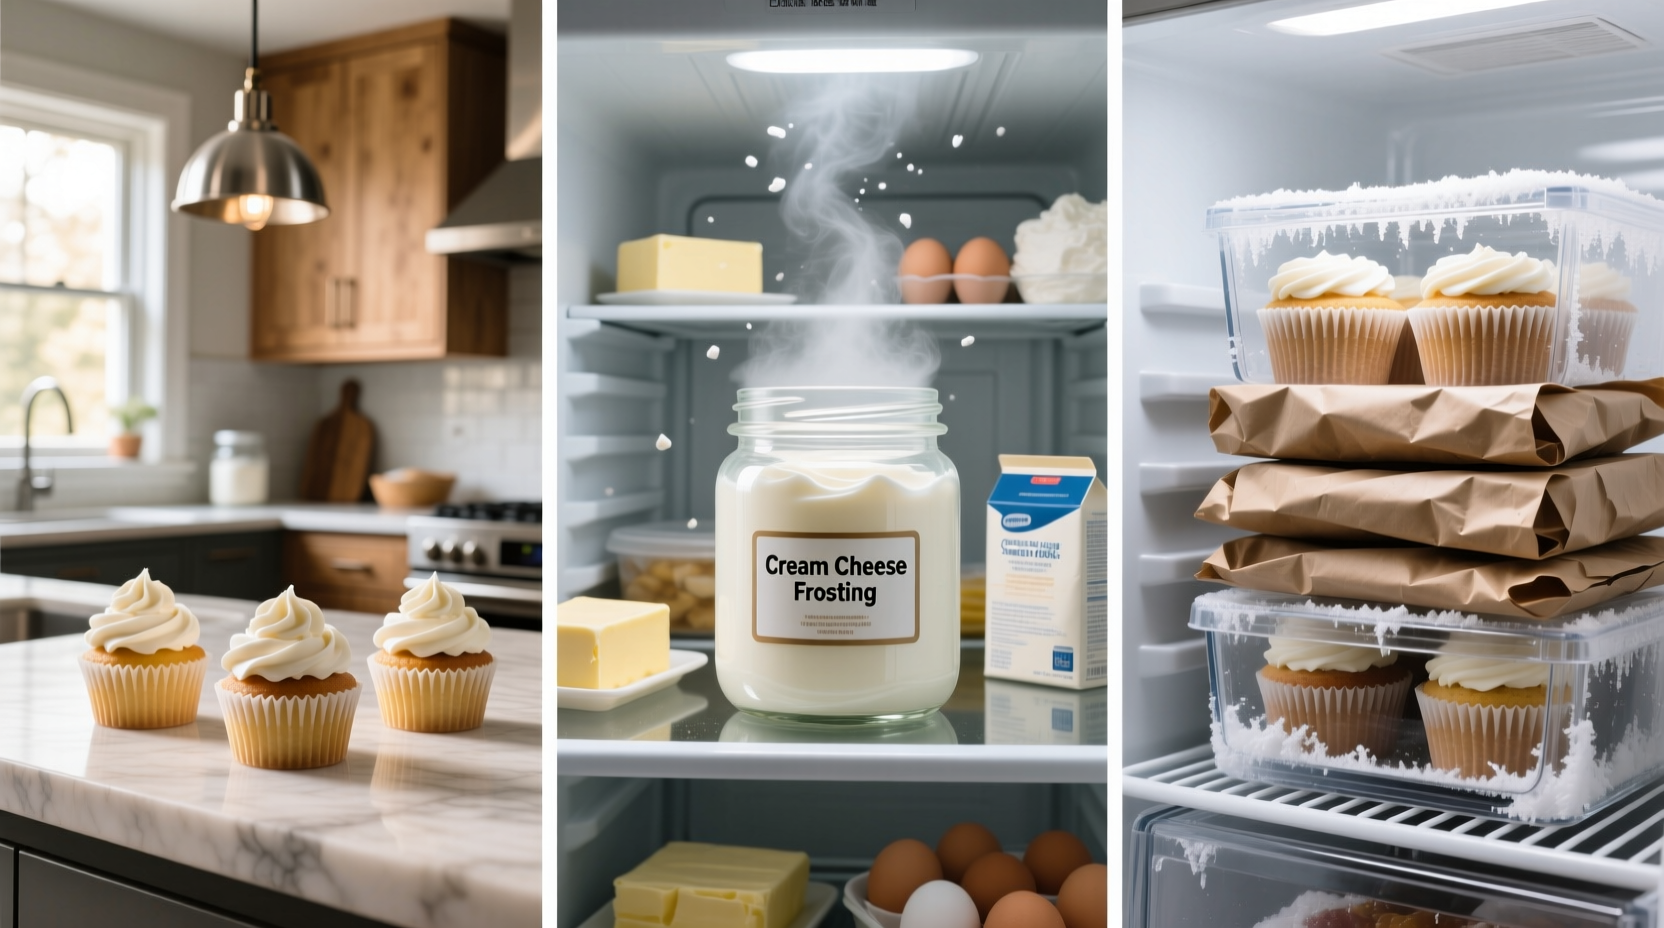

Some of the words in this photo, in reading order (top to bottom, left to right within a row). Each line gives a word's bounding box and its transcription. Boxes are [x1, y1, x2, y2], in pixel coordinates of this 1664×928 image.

[766, 554, 829, 575] Cream
[834, 555, 907, 576] Cheese
[794, 581, 877, 607] Frosting
